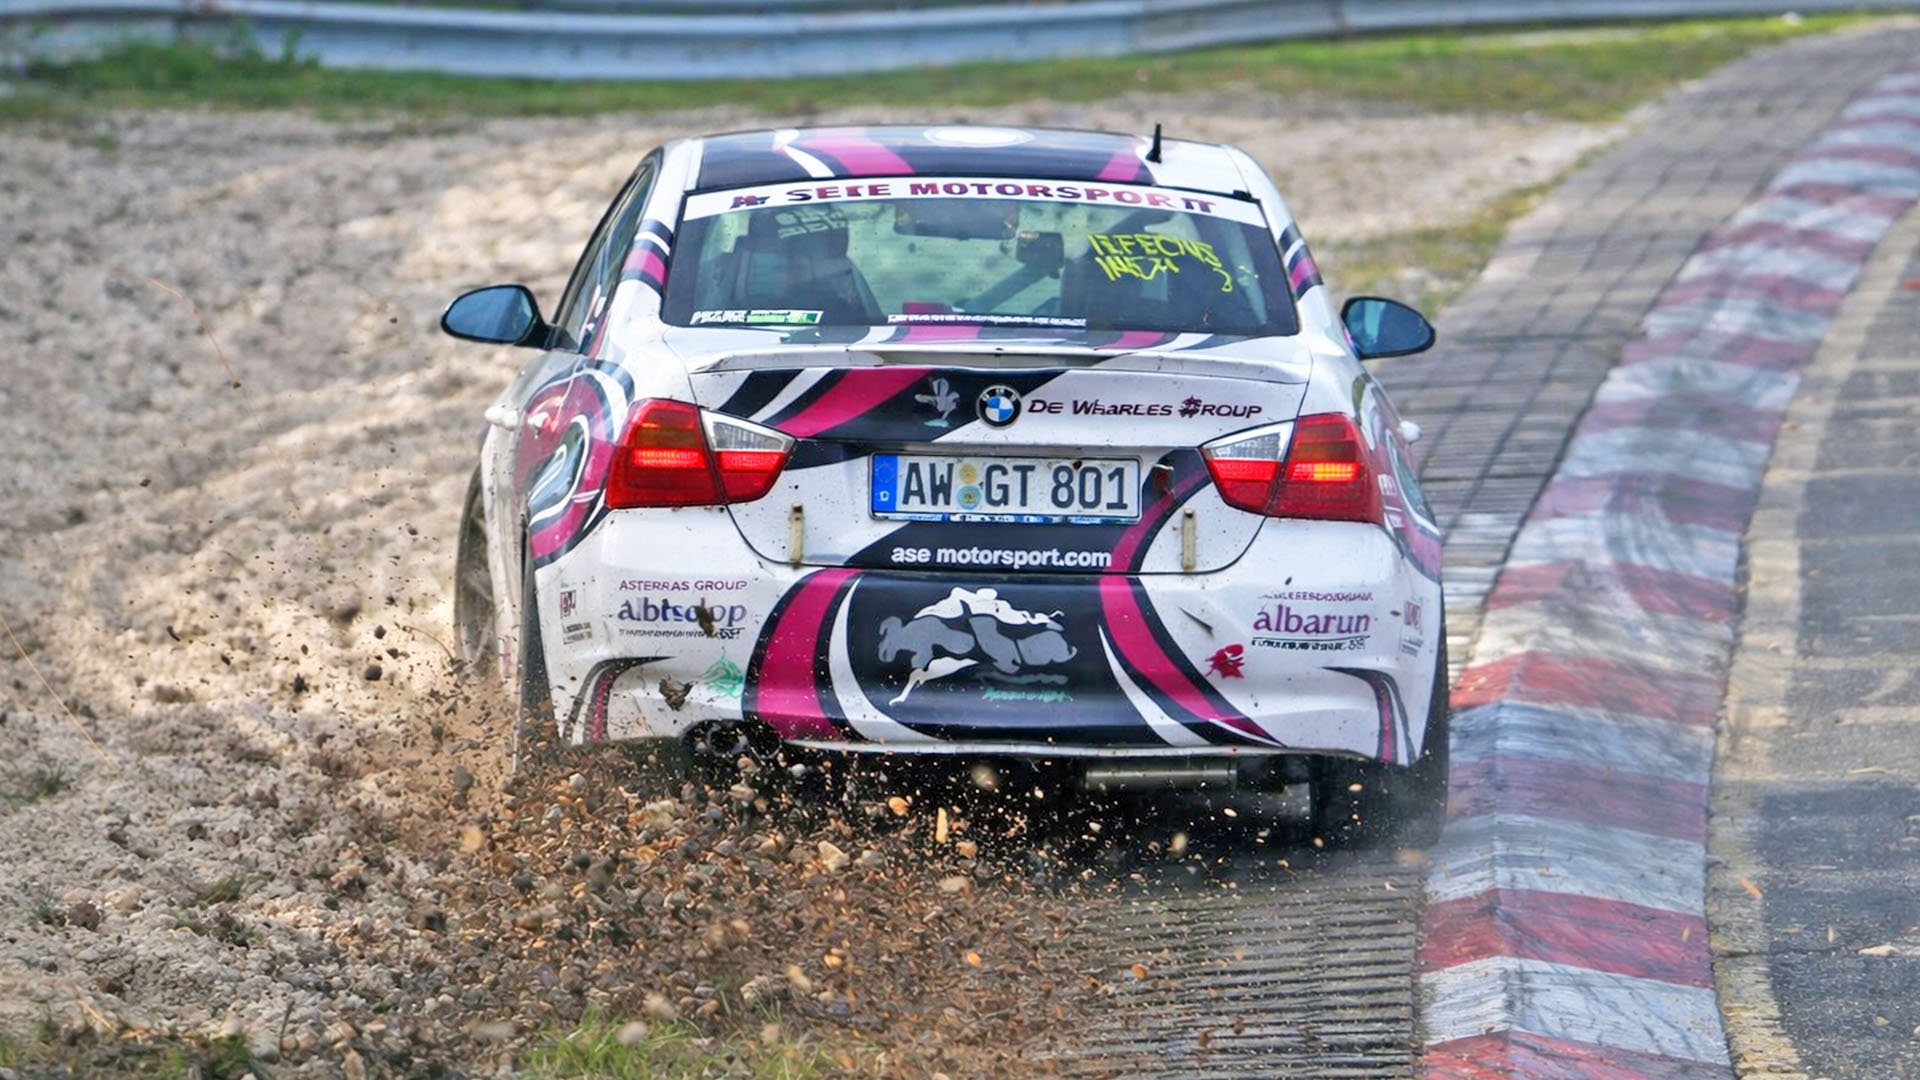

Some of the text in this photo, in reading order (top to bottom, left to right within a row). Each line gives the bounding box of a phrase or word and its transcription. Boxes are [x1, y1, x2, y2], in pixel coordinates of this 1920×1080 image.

[880, 491, 890, 502] D
[902, 462, 1129, 510] AW GT 801
[891, 547, 1112, 569] ase motorsport.com
[694, 580, 748, 591] GROUP
[1253, 604, 1371, 634] albarun
